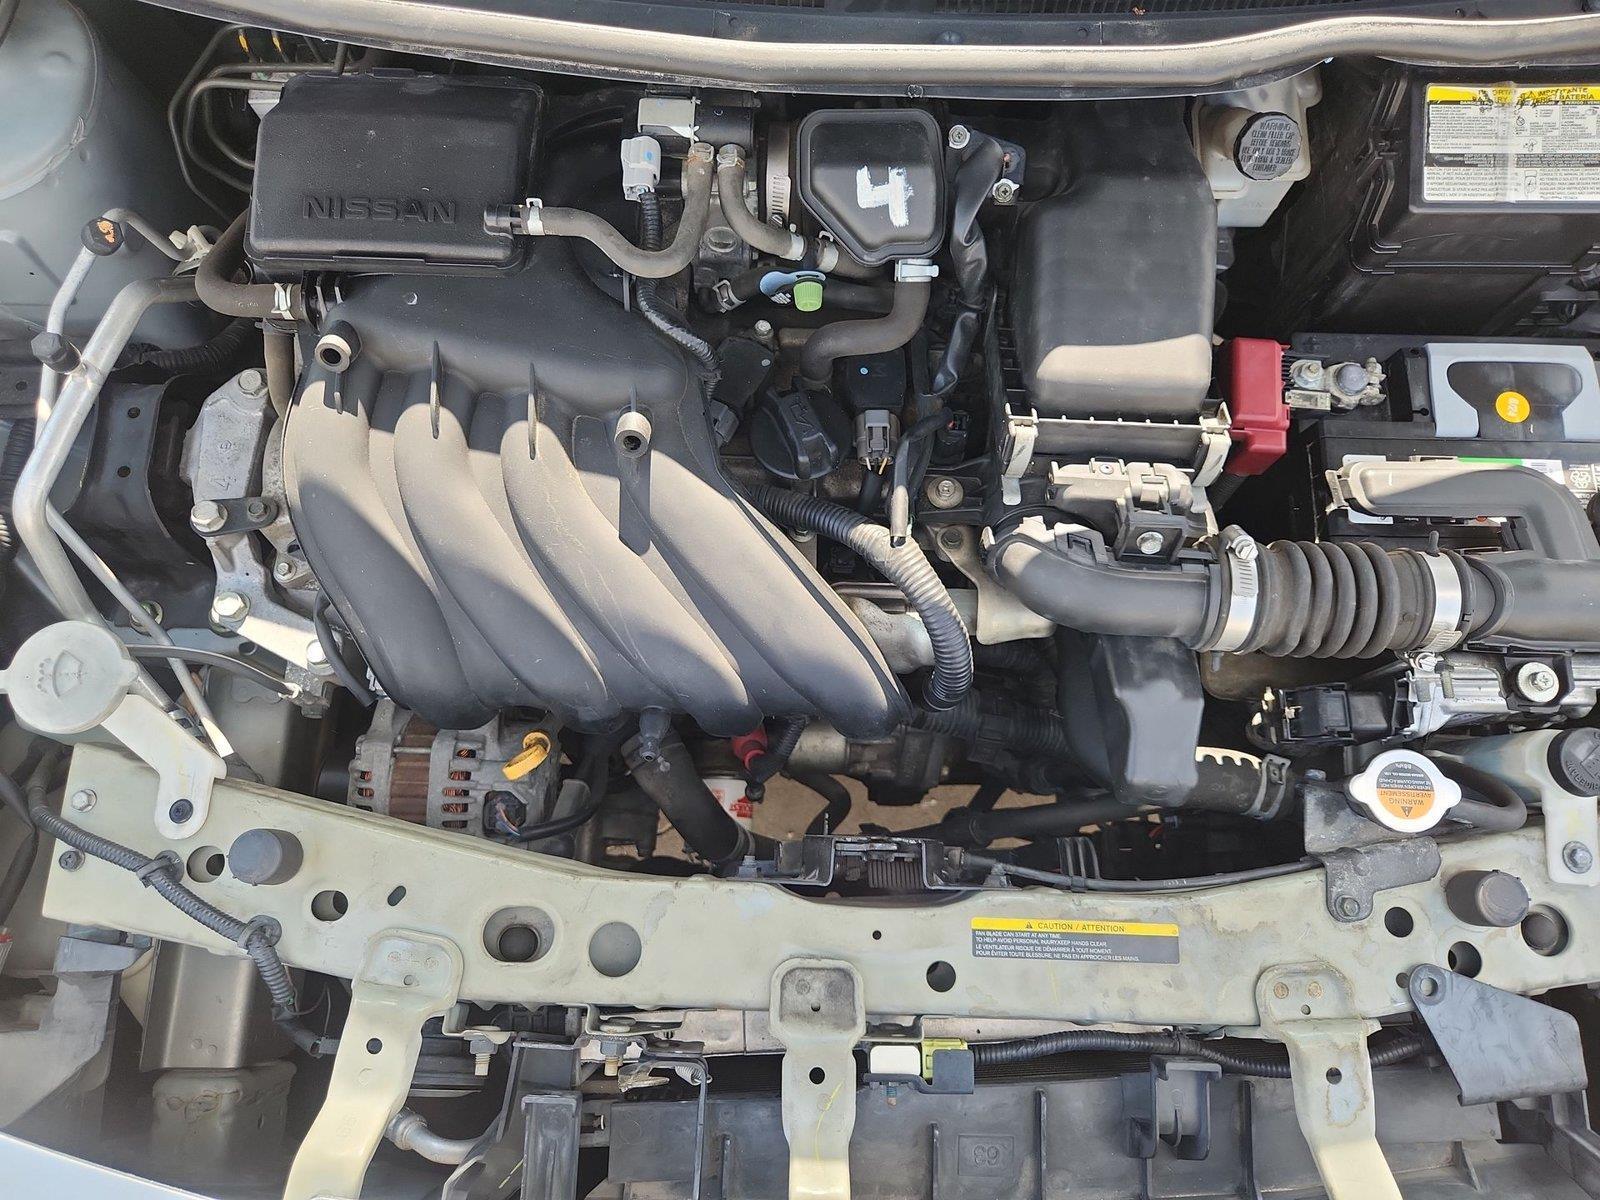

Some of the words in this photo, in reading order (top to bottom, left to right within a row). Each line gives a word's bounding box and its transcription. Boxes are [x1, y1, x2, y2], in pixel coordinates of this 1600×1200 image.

[856, 165, 911, 228] 4
[302, 194, 458, 225] NISSAN
[1380, 790, 1432, 798] AVERTISSEMENT
[1388, 798, 1425, 806] WARNING
[1038, 922, 1073, 930] CAUTION
[1081, 924, 1125, 932] ATTENTION
